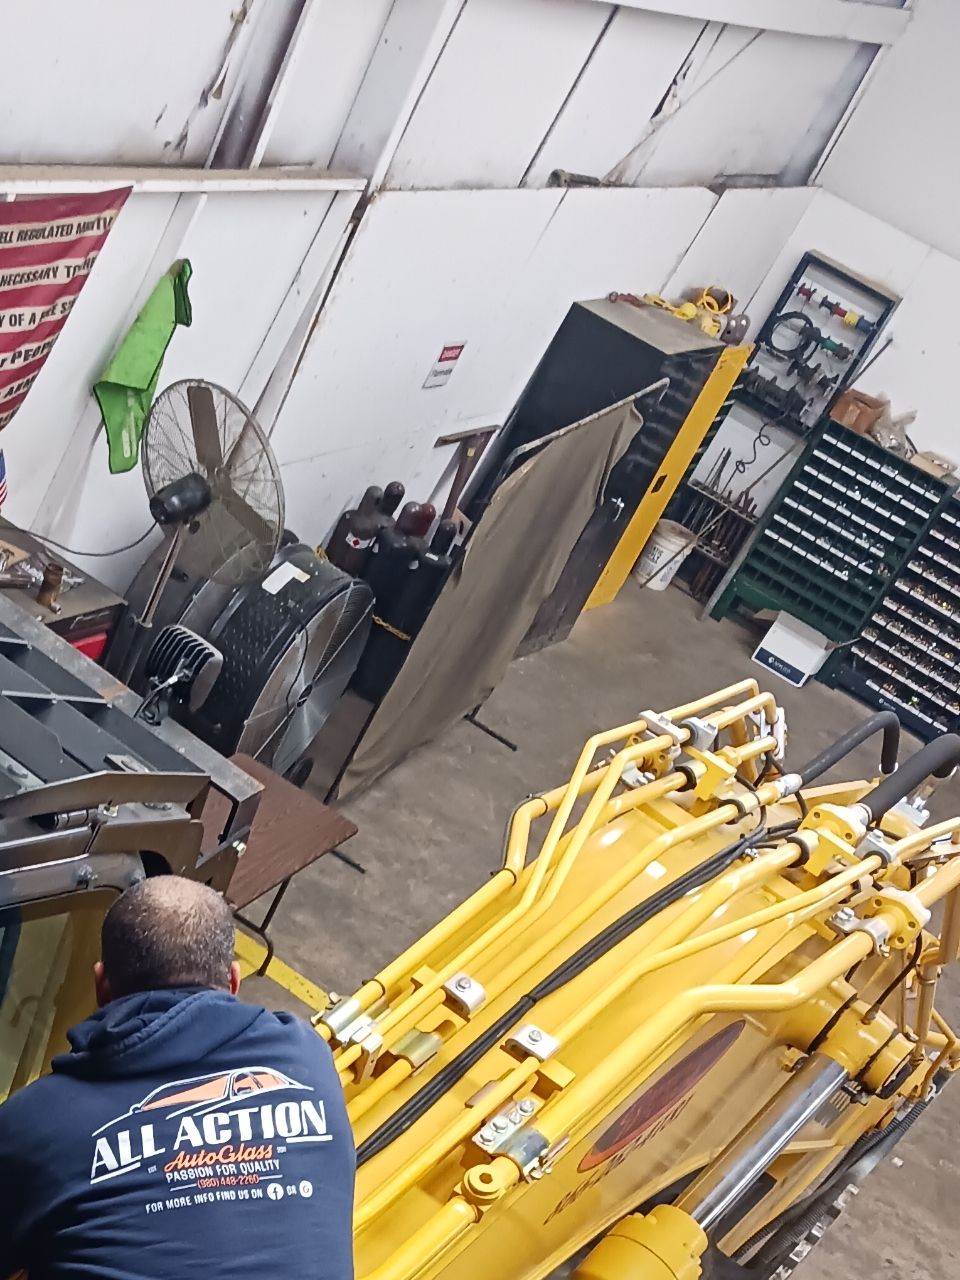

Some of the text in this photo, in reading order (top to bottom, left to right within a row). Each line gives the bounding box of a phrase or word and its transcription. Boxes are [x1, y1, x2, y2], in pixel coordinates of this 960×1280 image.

[16, 224, 73, 242] REGULATED
[0, 266, 58, 287] NECESSARY
[9, 313, 24, 326] OF
[29, 313, 36, 325] A
[11, 337, 56, 364] PEOP
[3, 373, 36, 398] ARM
[91, 1100, 327, 1178] ALL ACTION
[164, 1143, 272, 1172] AutoGlass
[165, 1160, 280, 1183] PASSION FOR QUALITY
[146, 1203, 163, 1214] FOR
[166, 1195, 191, 1209] MORE
[194, 1192, 214, 1204] INFO
[216, 1190, 235, 1200] FIND
[238, 1190, 249, 1199] US
[252, 1189, 263, 1198] ON
[286, 1185, 297, 1195] OR
